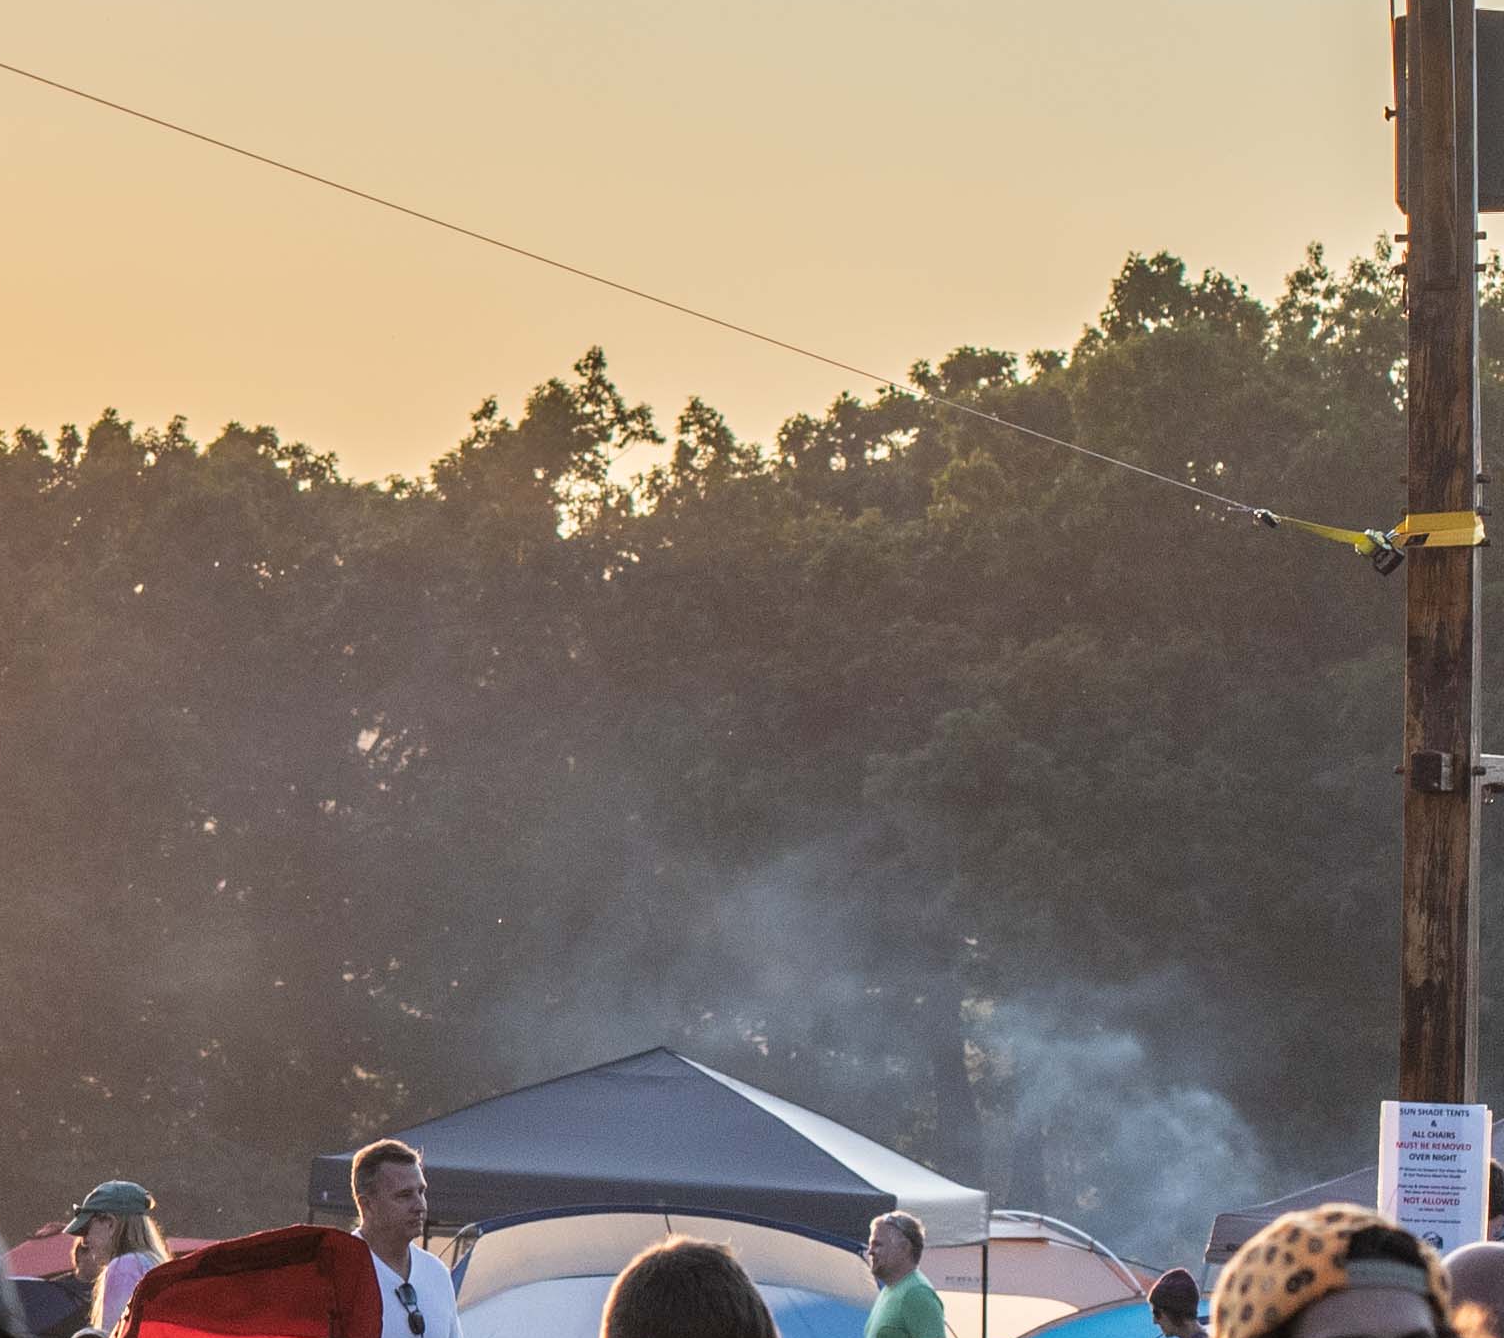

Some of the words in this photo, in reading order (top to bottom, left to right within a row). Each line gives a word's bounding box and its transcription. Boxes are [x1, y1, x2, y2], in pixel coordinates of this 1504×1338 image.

[1399, 1108, 1416, 1116] SUN
[1418, 1108, 1443, 1117] SHADE
[1446, 1109, 1470, 1118] TENTS
[1412, 1131, 1425, 1139] ALL
[1427, 1131, 1456, 1139] CHAIRS
[1396, 1141, 1418, 1149] MUST
[1420, 1142, 1430, 1150] BE
[1432, 1143, 1472, 1151] REMOVED
[1409, 1153, 1431, 1161] OVER
[1433, 1154, 1457, 1162] NIGHT
[1403, 1197, 1420, 1205] NOT
[1422, 1197, 1460, 1206] ALLOWED
